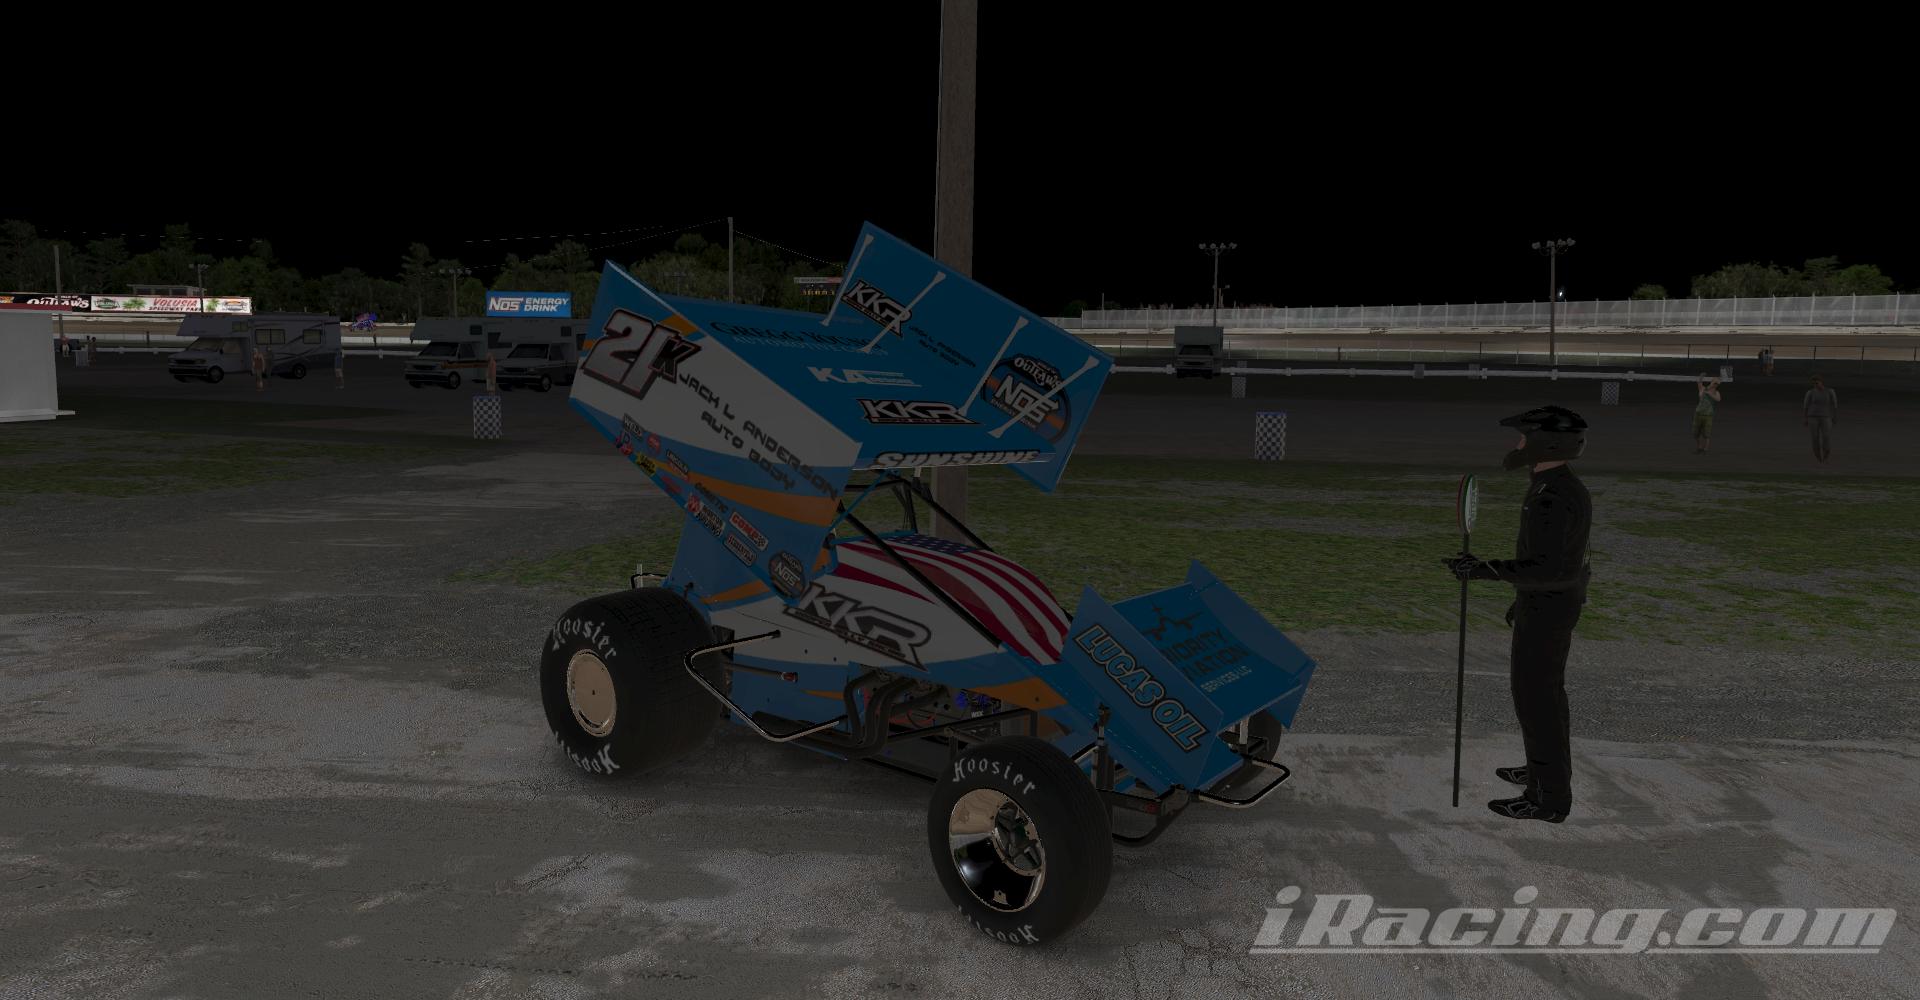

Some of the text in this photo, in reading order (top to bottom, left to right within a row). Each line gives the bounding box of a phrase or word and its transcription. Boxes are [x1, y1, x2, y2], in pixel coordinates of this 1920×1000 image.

[153, 298, 198, 307] VOLUSIA
[489, 296, 523, 311] NOS
[524, 304, 559, 312] DRINK
[525, 297, 569, 305] ENERGY
[843, 280, 912, 337] KKR
[857, 398, 982, 424] KKR
[679, 373, 838, 499] JACK L ANDERSON
[701, 411, 744, 449] AUTO
[748, 449, 795, 490] BODY
[552, 616, 616, 660] Hoosier
[794, 582, 931, 672] KKR
[1073, 624, 1210, 753] LUCAS OIL
[953, 757, 1035, 795] Hoosier
